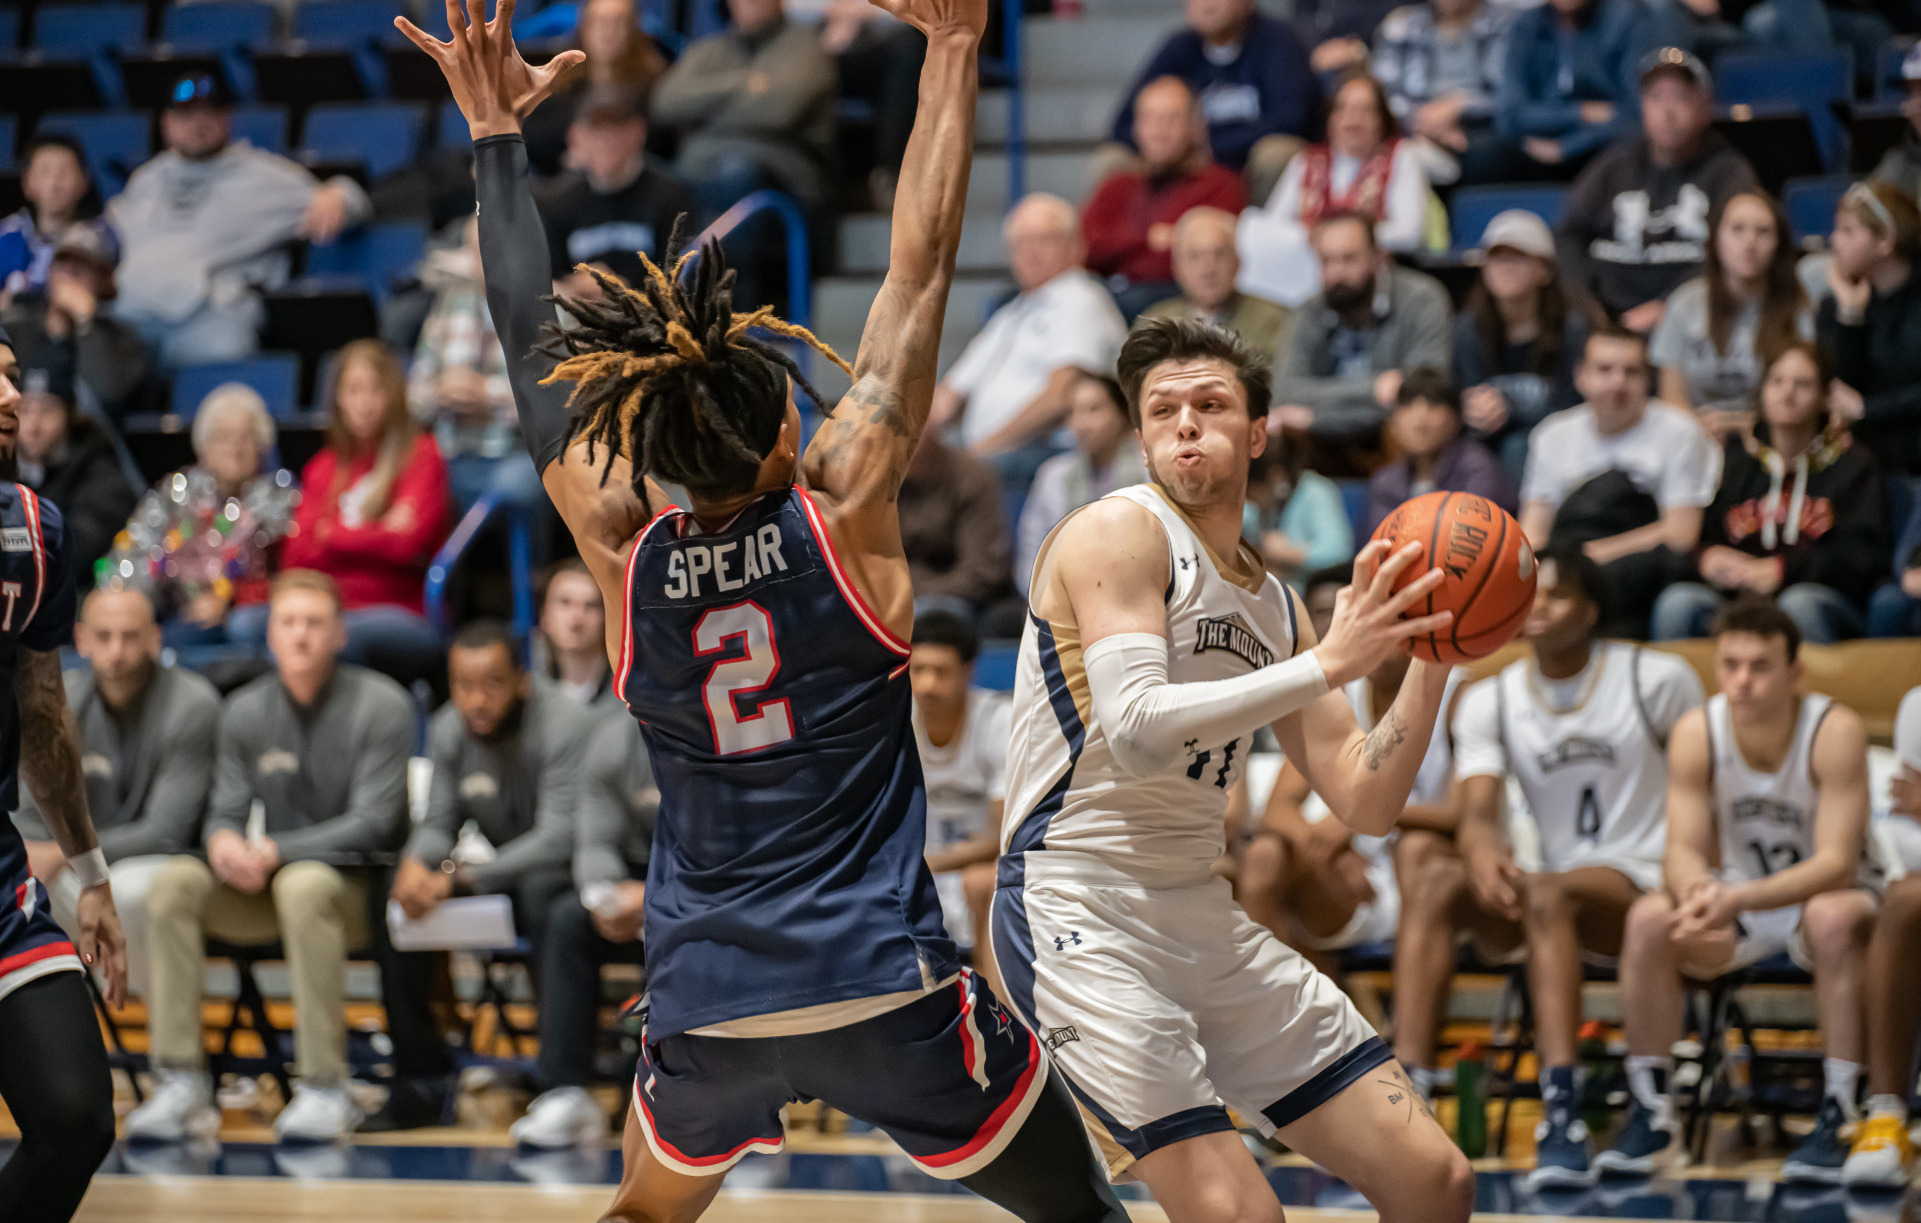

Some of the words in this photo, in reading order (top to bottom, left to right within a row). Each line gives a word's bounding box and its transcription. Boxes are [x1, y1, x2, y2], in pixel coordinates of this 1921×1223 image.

[664, 523, 788, 599] SPEAR
[1445, 521, 1488, 581] ROCK
[1195, 618, 1229, 654] THE
[1229, 624, 1274, 669] MOUNT
[691, 599, 796, 755] 2
[1576, 785, 1601, 840] 4
